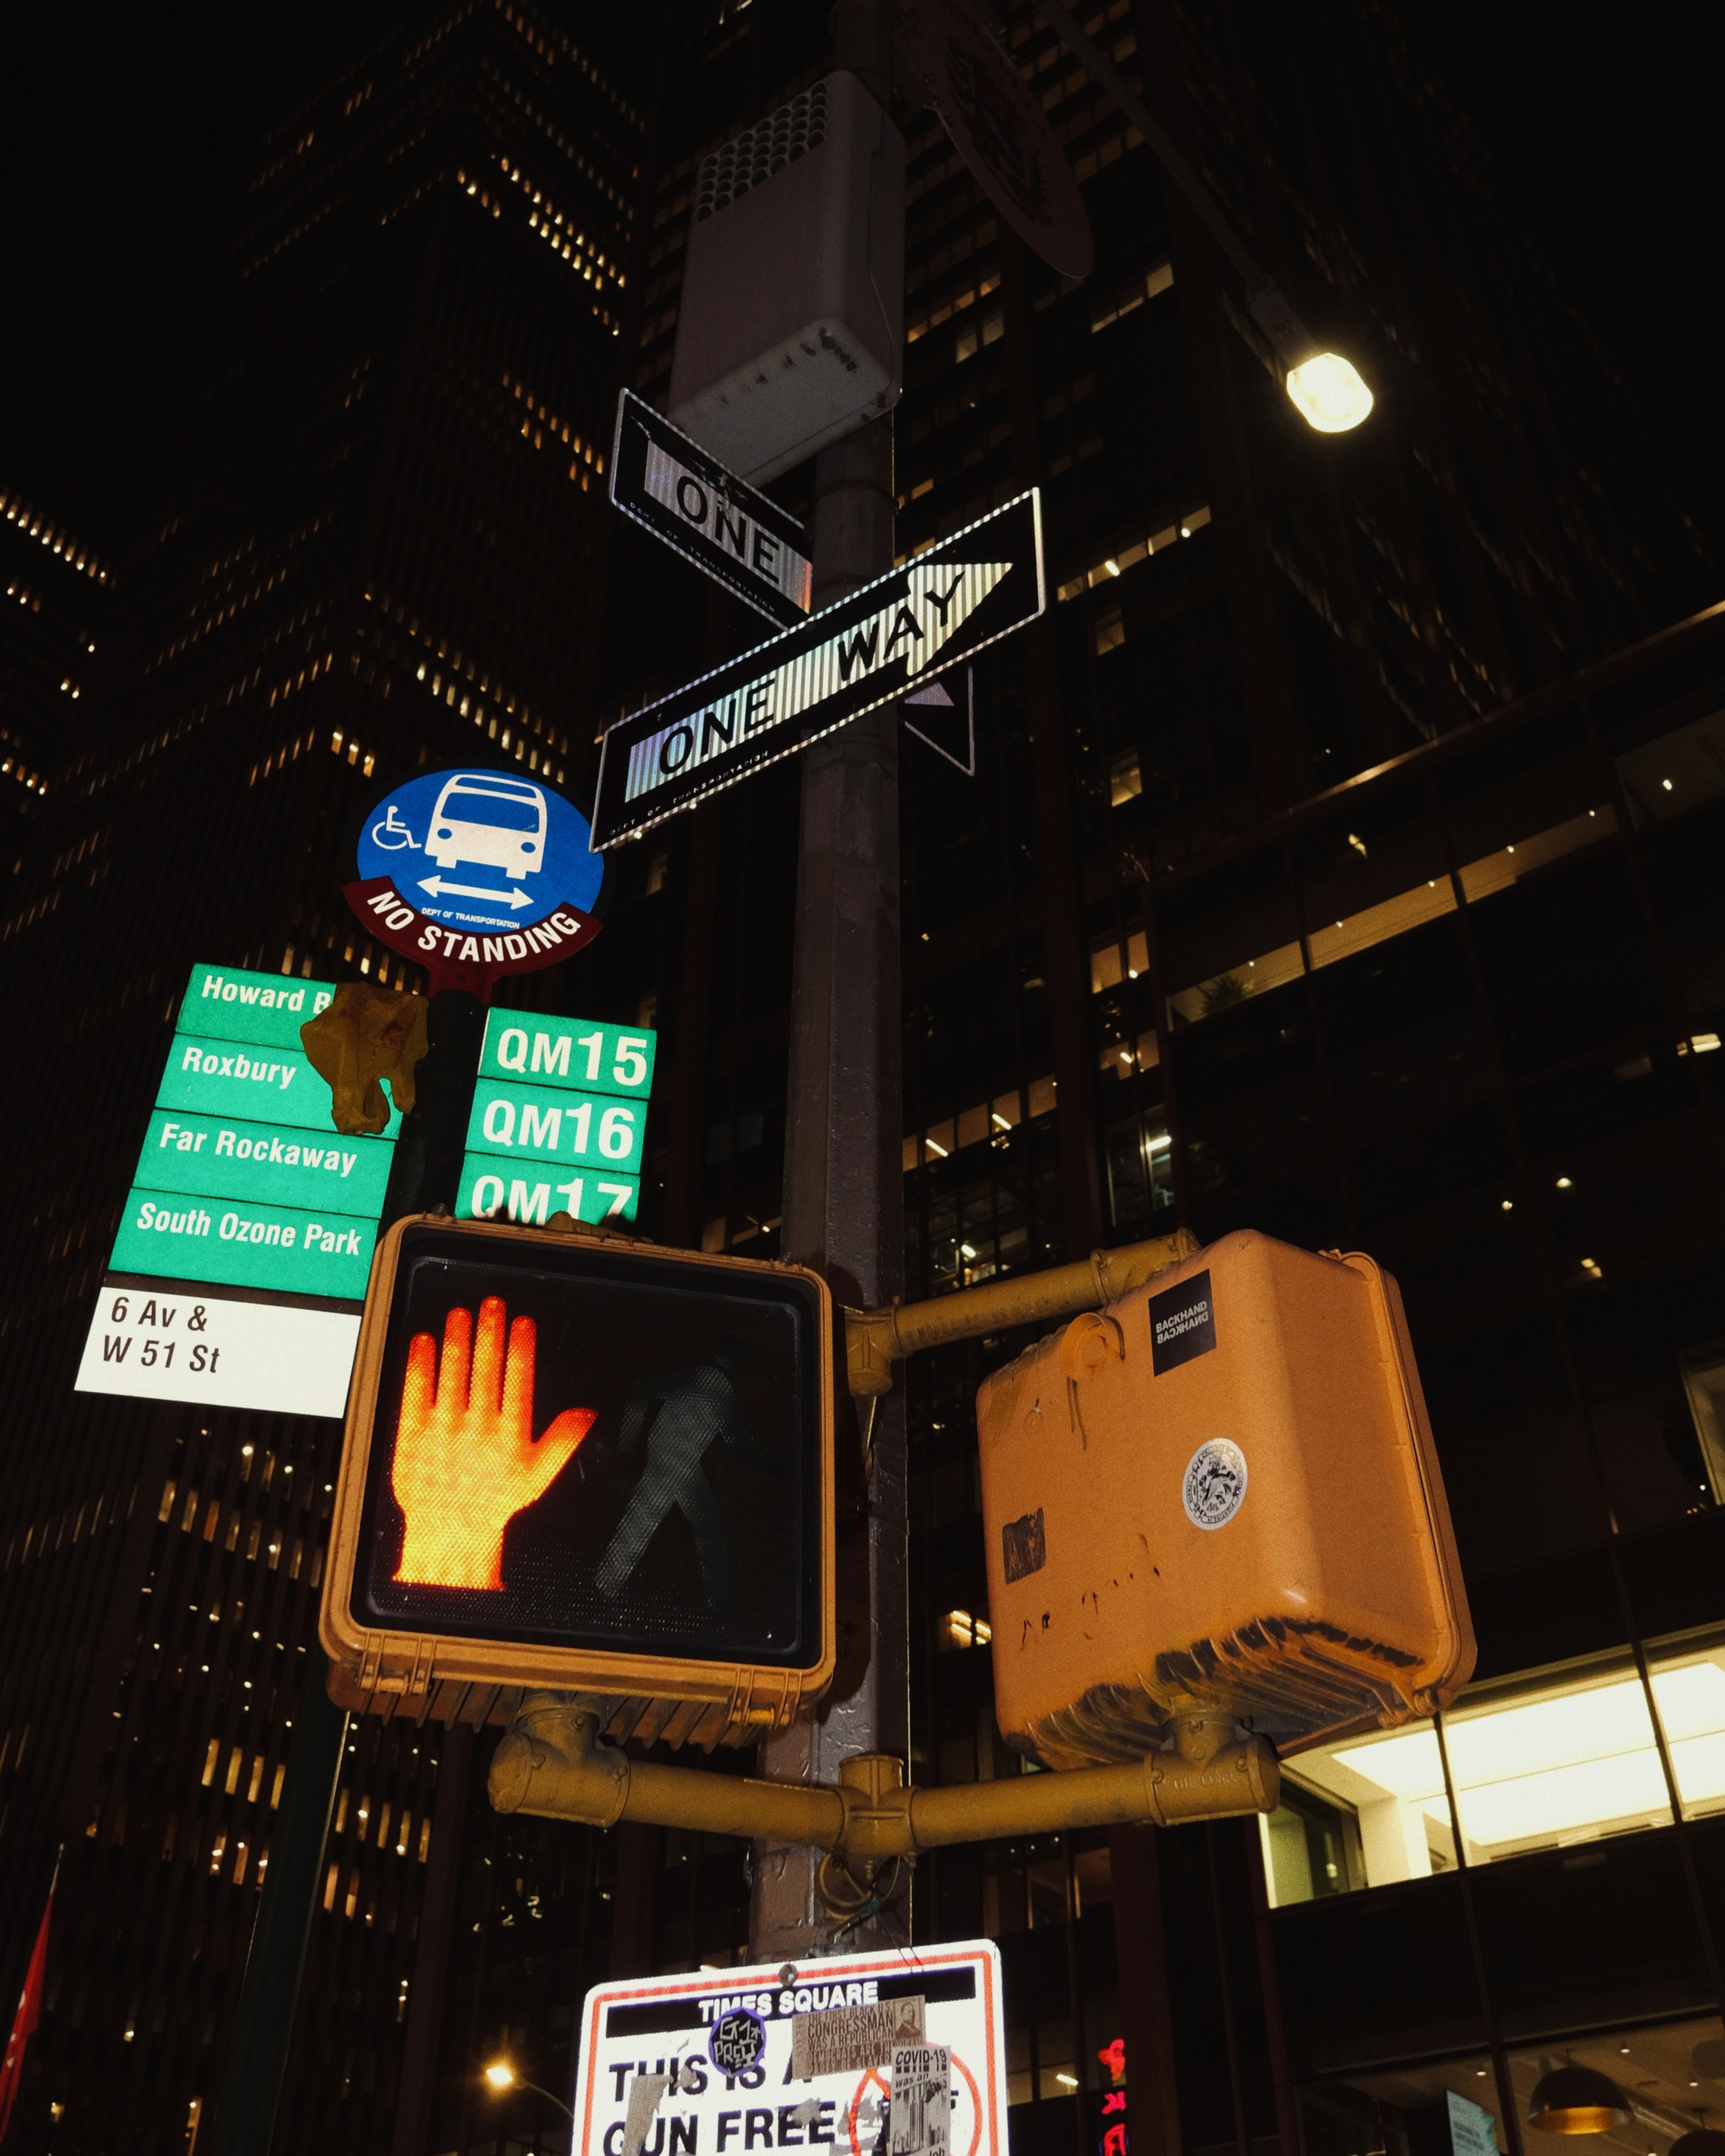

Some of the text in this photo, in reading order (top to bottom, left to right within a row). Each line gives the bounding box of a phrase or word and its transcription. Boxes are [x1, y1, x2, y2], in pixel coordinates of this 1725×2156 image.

[677, 475, 779, 585] ONE
[630, 501, 775, 613] DEPT OF TRANSPORTATION
[660, 571, 966, 774] ONE WAY
[610, 750, 769, 836] DEPT OF TRANSPORTATION
[367, 891, 582, 962] NO STANDING
[421, 907, 521, 930] DEPT OF TRANSPORTATION
[201, 975, 305, 1011] Howard
[182, 1047, 297, 1090] Roxbury
[498, 1028, 647, 1086] QM15
[160, 1123, 358, 1177] Far Rockaway
[483, 1100, 635, 1159] QM16
[471, 1175, 633, 1226] QM17
[137, 1202, 362, 1255] South Ozone Park
[111, 1297, 207, 1331] 6 Av &
[1156, 1300, 1207, 1334] BACKHAND
[103, 1335, 220, 1373] W 51 St
[698, 1981, 878, 2022] TIMES SQUARE
[808, 2012, 821, 2024] THE
[826, 2009, 847, 2021] FIRST
[850, 2004, 875, 2018] BLACK
[807, 2012, 893, 2039] CONGRESSMAN
[808, 2037, 828, 2051] WAS
[831, 2037, 836, 2048] A
[838, 2028, 893, 2047] REPUBLICAN
[807, 2045, 857, 2063] DEMOCRATS
[861, 2043, 874, 2055] ARE
[896, 2049, 947, 2066] COVID-19
[896, 2073, 929, 2088] was an
[717, 2101, 835, 2153] FREE
